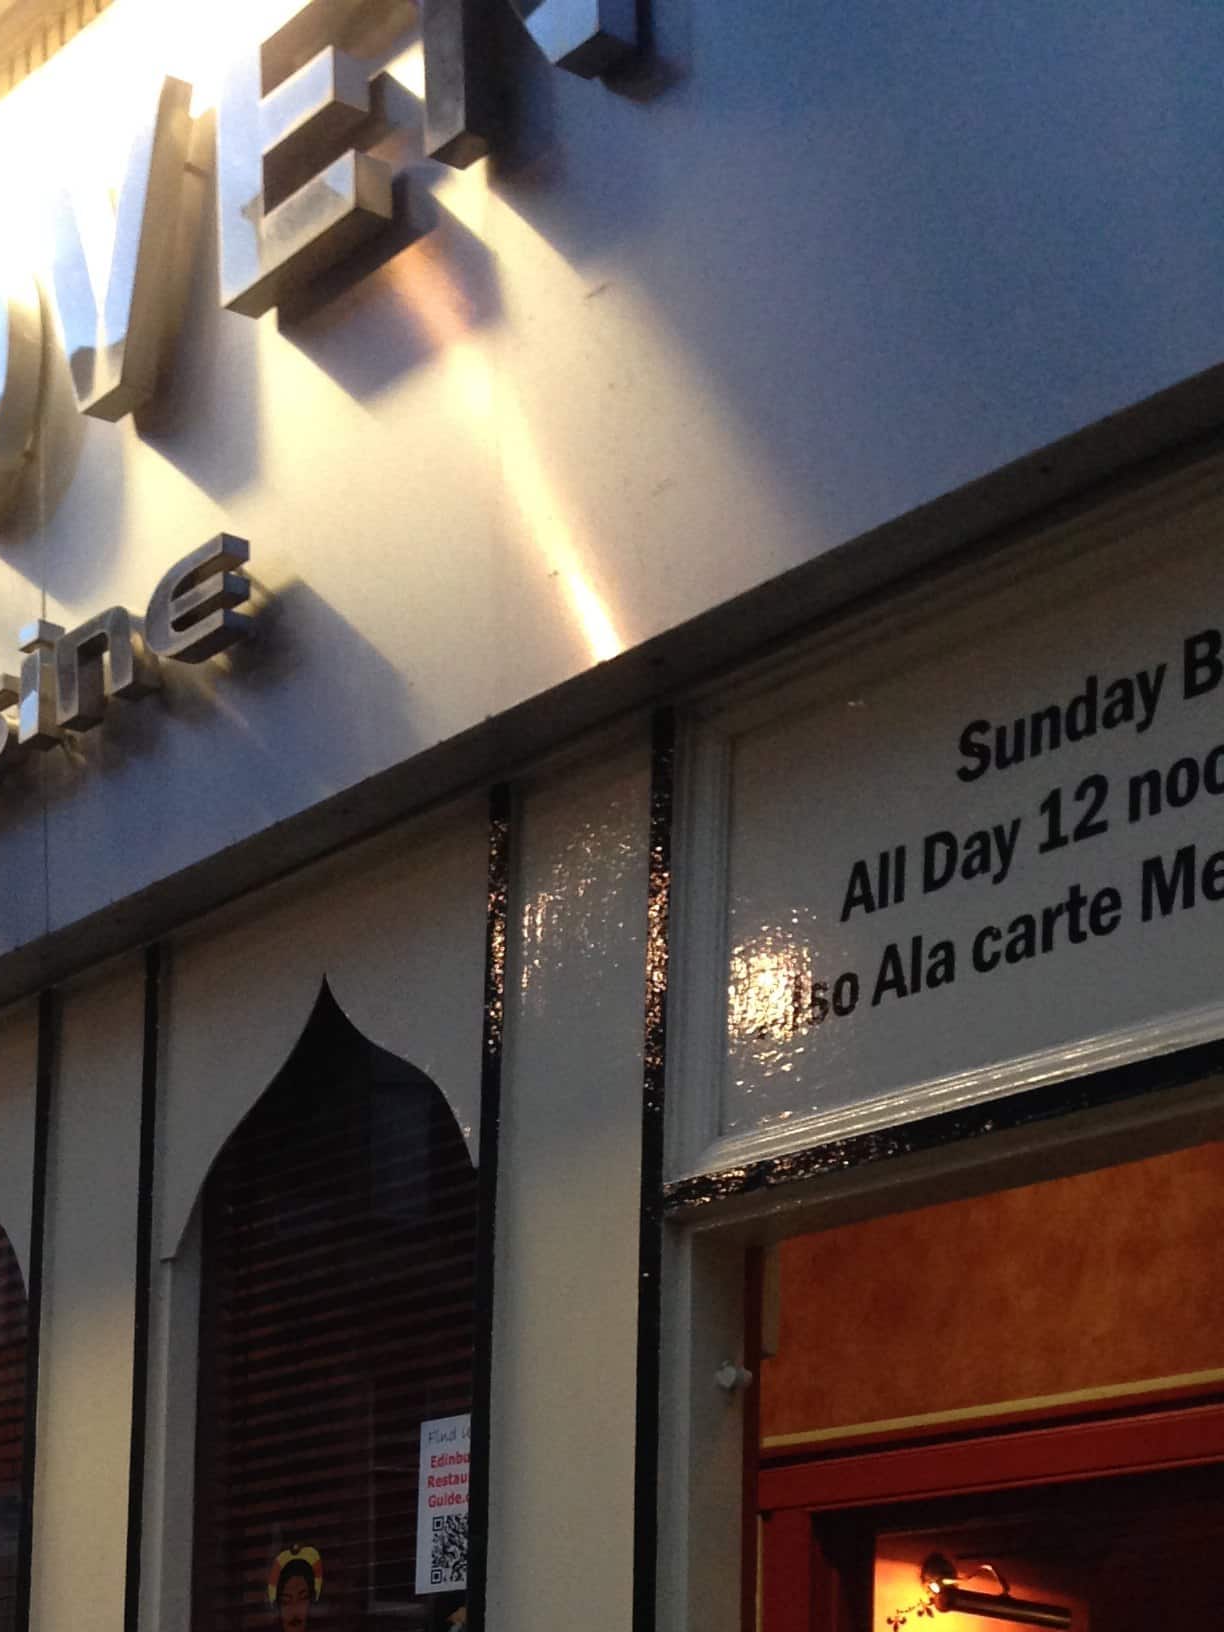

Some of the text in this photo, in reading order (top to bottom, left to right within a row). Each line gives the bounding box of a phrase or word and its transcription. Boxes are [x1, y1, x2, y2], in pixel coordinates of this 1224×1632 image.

[956, 662, 1168, 784] Sunday
[839, 844, 907, 923] All
[922, 818, 1021, 894] Day
[1038, 773, 1110, 854] 12
[872, 933, 956, 1008] Ala
[971, 883, 1123, 974] carte
